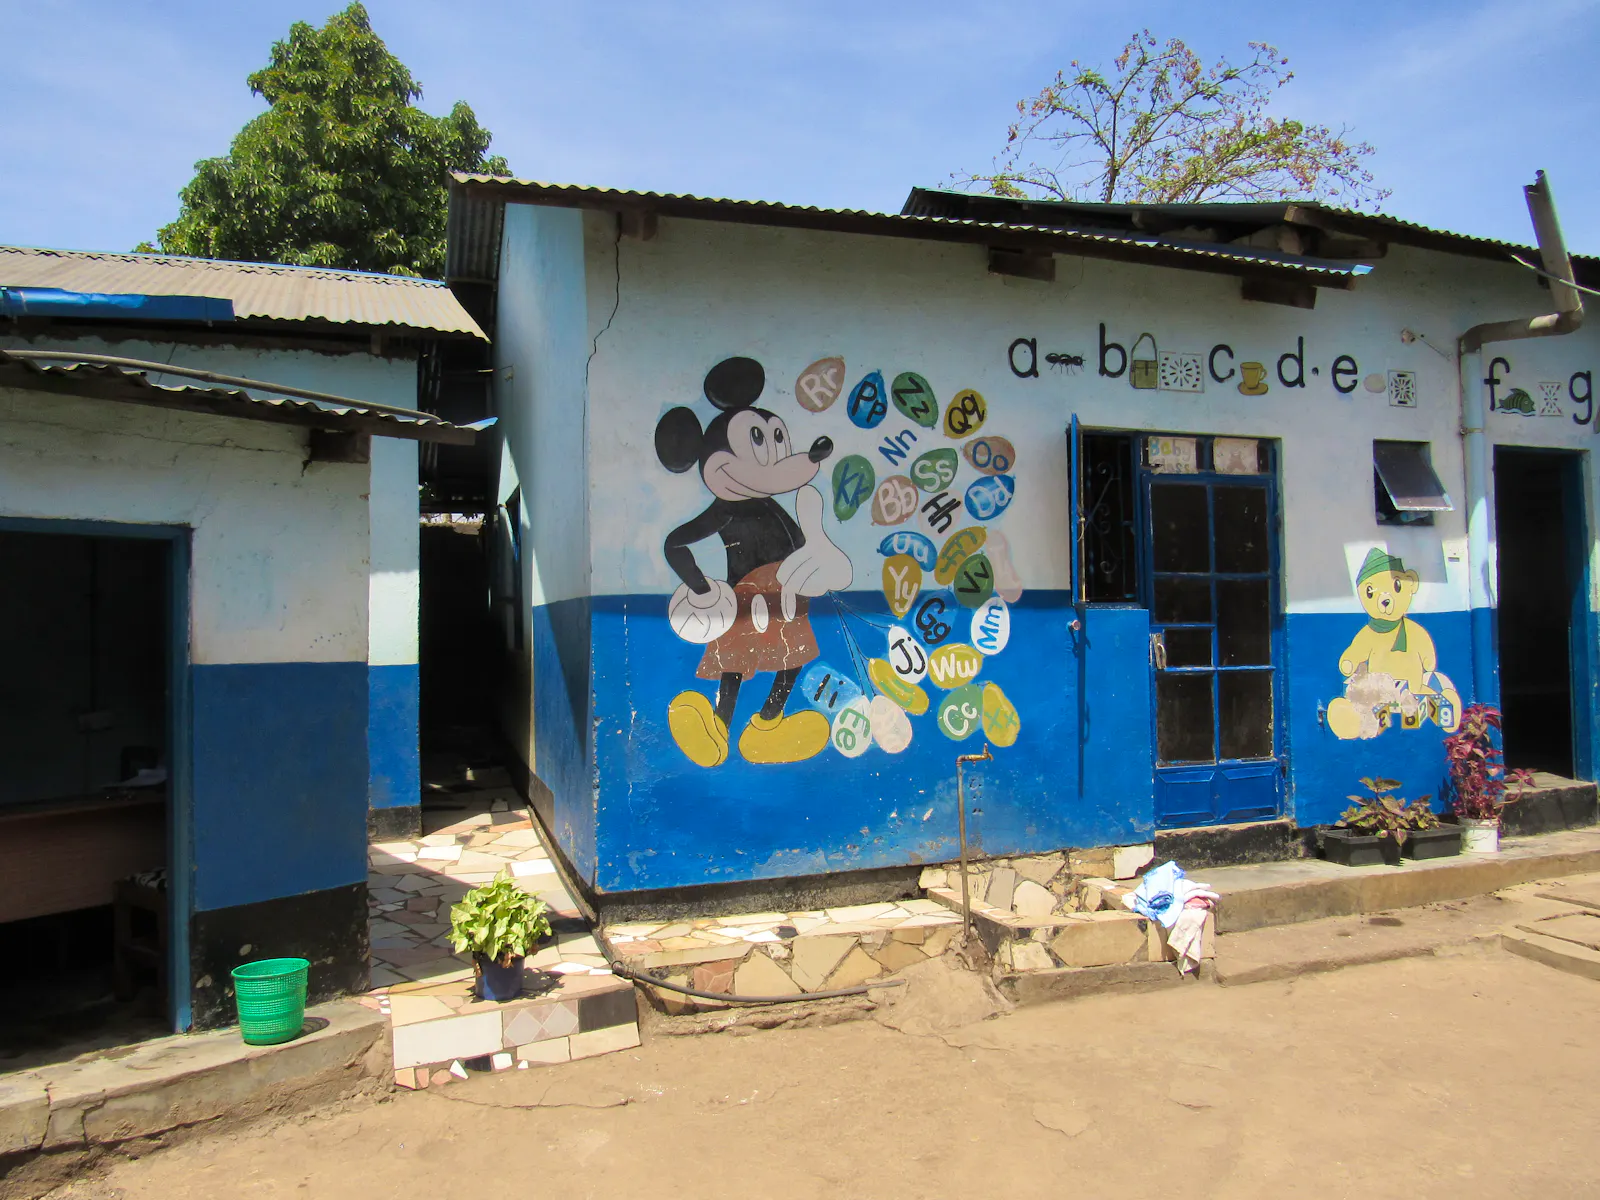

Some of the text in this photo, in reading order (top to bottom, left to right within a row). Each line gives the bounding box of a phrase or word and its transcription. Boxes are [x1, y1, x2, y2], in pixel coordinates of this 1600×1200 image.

[800, 367, 838, 408] Rr
[1007, 323, 1592, 425] a b c d e f g
[851, 381, 887, 422] Pp
[894, 377, 930, 418] Zz
[948, 394, 985, 434] Qq
[878, 429, 917, 466] Nn
[973, 441, 1008, 471] Oo
[834, 463, 869, 508] Kk
[914, 459, 953, 493] Ss
[878, 480, 917, 522] Bb
[921, 492, 961, 534] Hh
[969, 477, 1013, 518] Dd
[892, 534, 929, 564] Uu
[889, 565, 918, 613] Yy
[958, 562, 990, 594] Vv
[916, 597, 951, 645] Gg
[977, 604, 1003, 650] Mm
[891, 637, 926, 674] Jj
[931, 653, 979, 682] Ww
[836, 708, 871, 751] Ee
[944, 702, 977, 736] Cc
[984, 709, 1018, 731] Xx
[1440, 708, 1451, 725] 9
